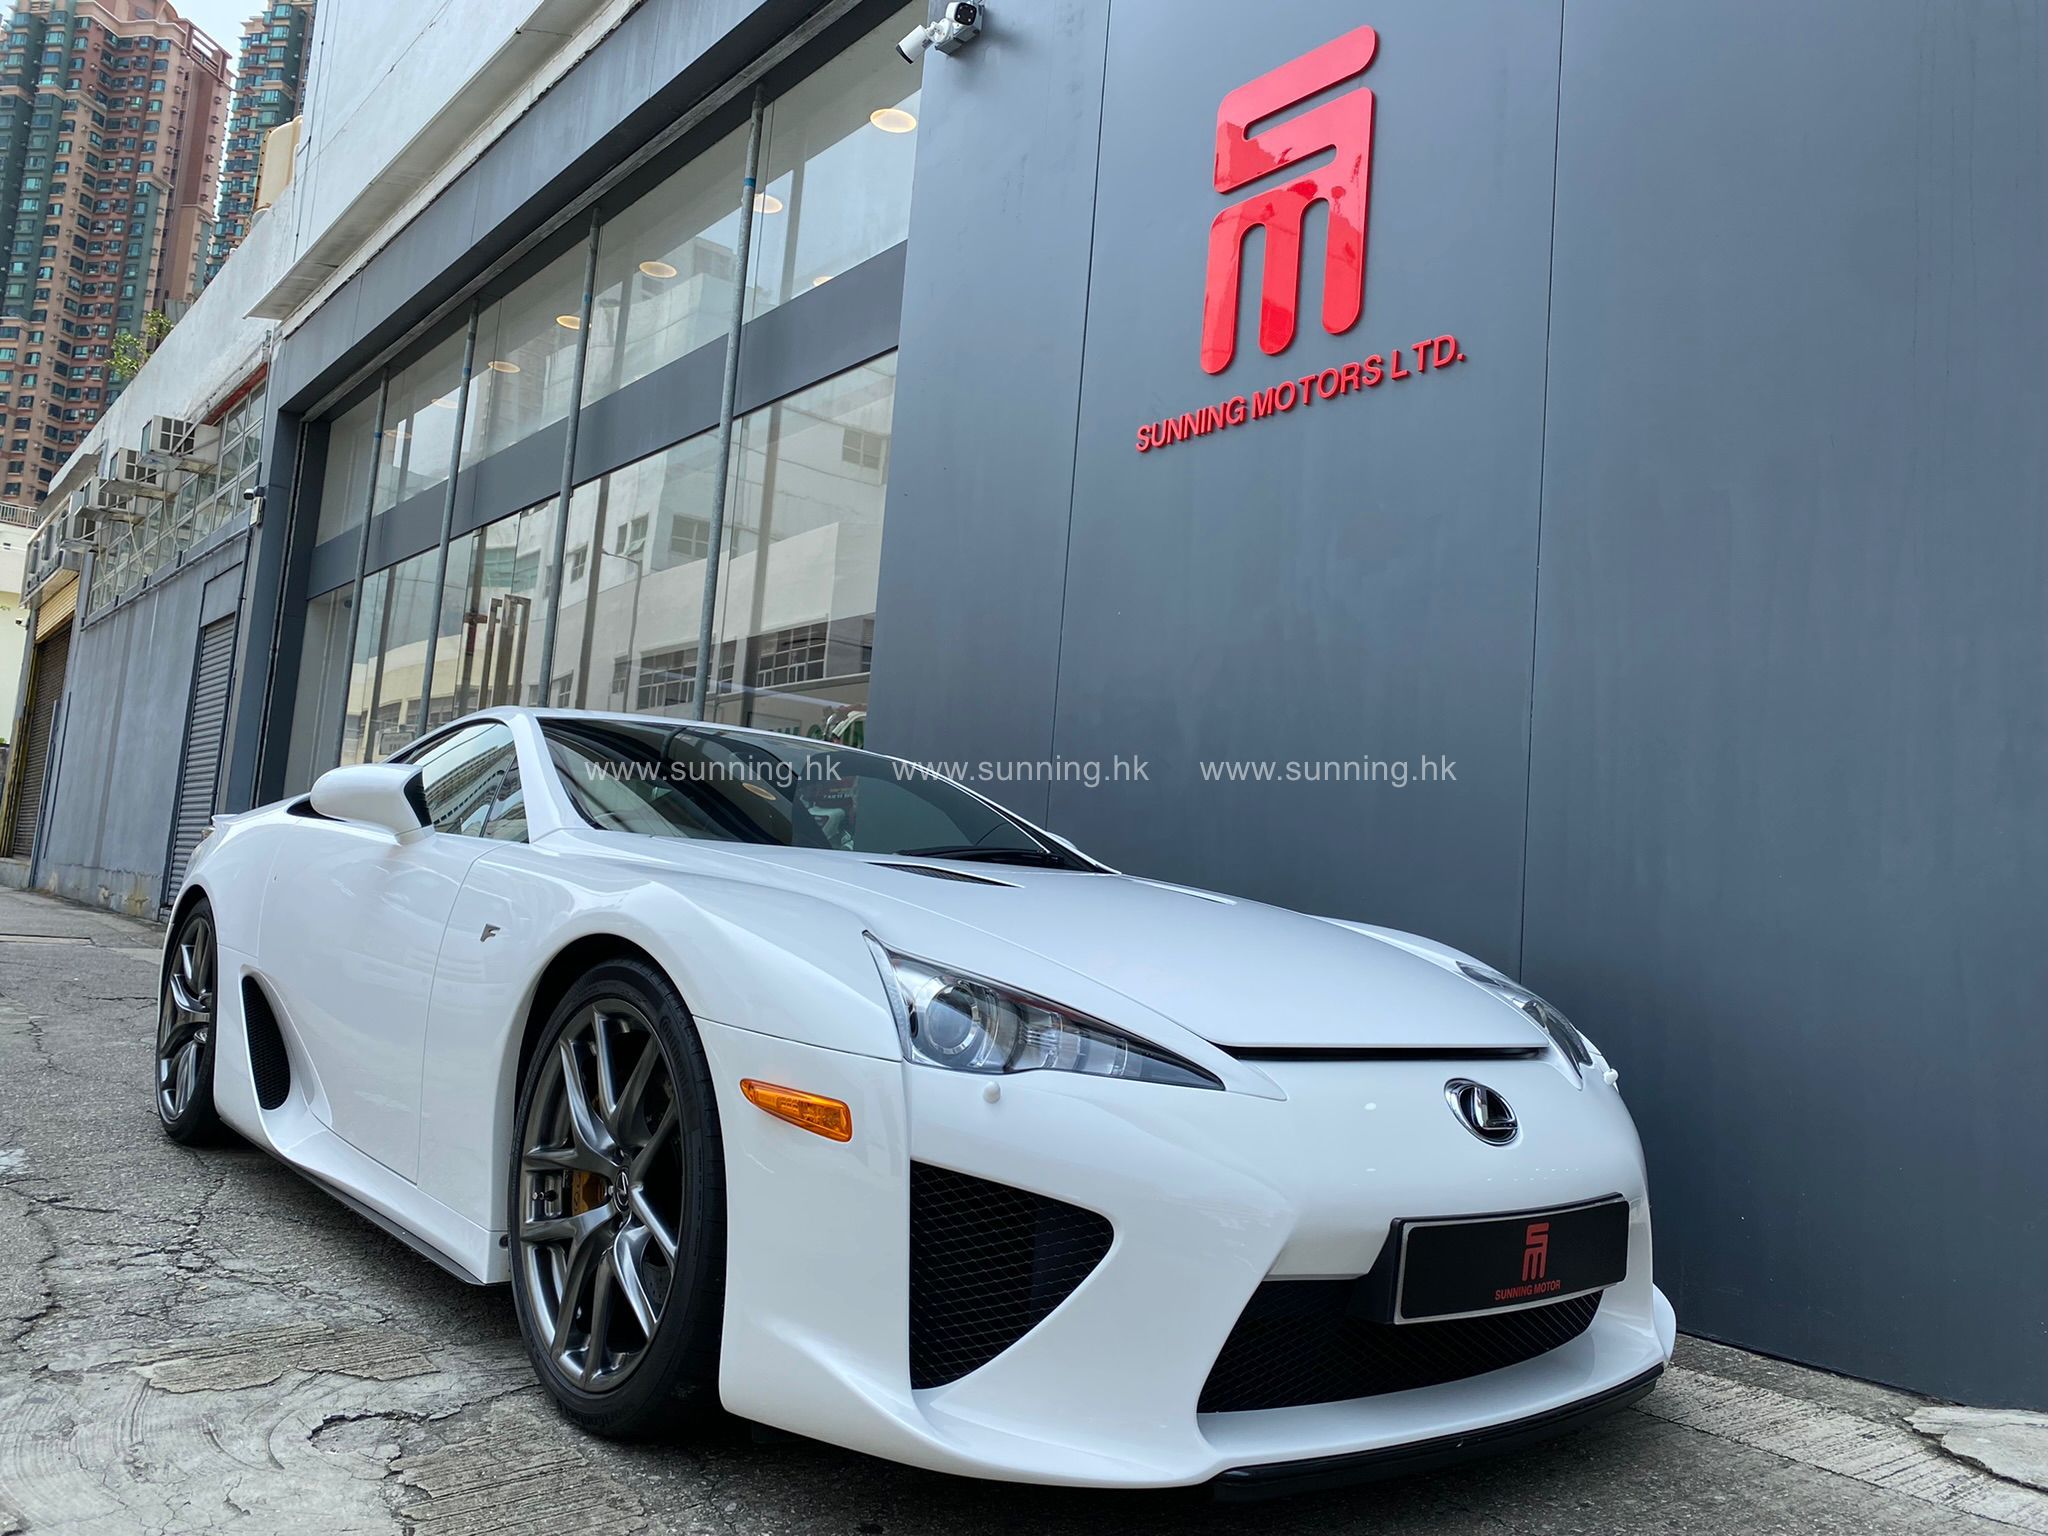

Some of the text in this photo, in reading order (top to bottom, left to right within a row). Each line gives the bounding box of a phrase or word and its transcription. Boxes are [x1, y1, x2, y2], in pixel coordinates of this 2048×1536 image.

[1136, 334, 1466, 453] SUNNING MOTORS LTD.
[1495, 1280, 1561, 1300] SUNNING MOTOR
